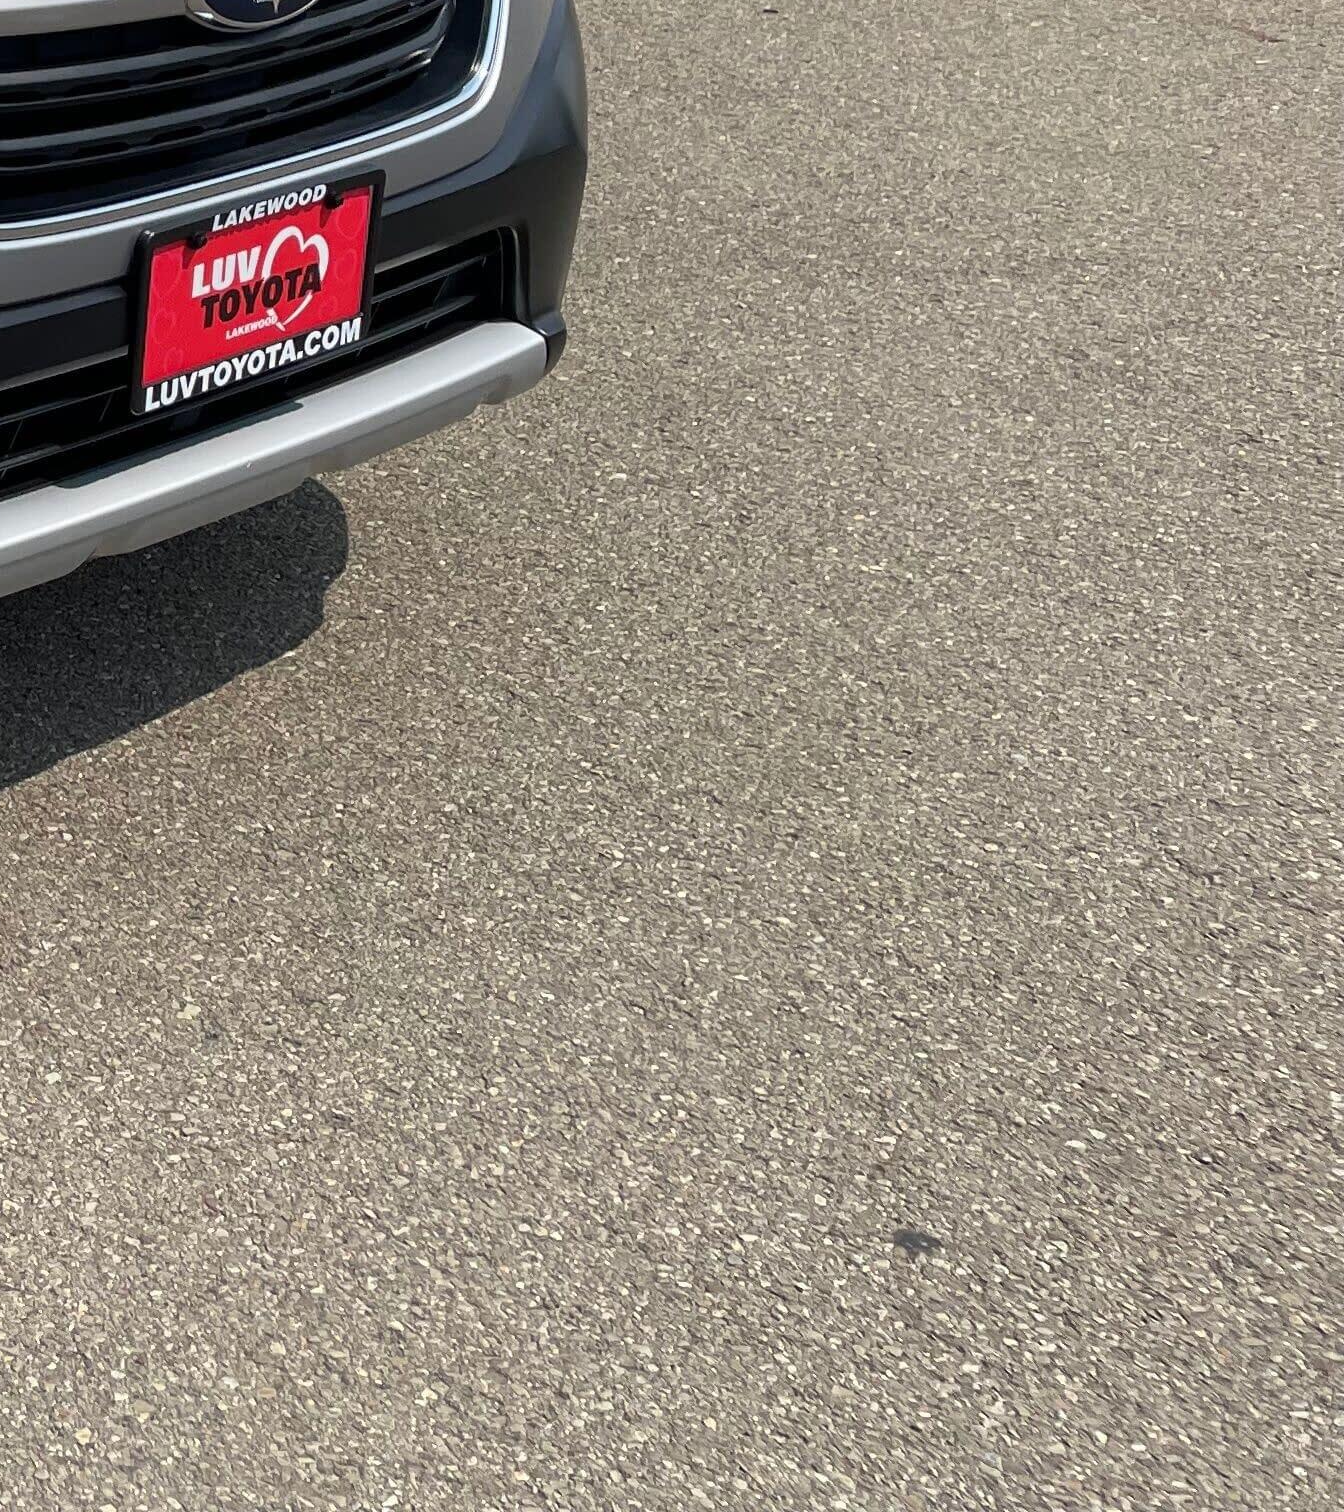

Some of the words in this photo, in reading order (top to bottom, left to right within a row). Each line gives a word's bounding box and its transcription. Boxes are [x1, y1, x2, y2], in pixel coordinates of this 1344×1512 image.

[212, 184, 327, 232] LAKEWOOD
[192, 245, 262, 298] LUV
[201, 263, 322, 328] TOYOTA
[226, 315, 278, 340] LAKEWOOD
[145, 317, 362, 411] LUVTOYOTA.COM
